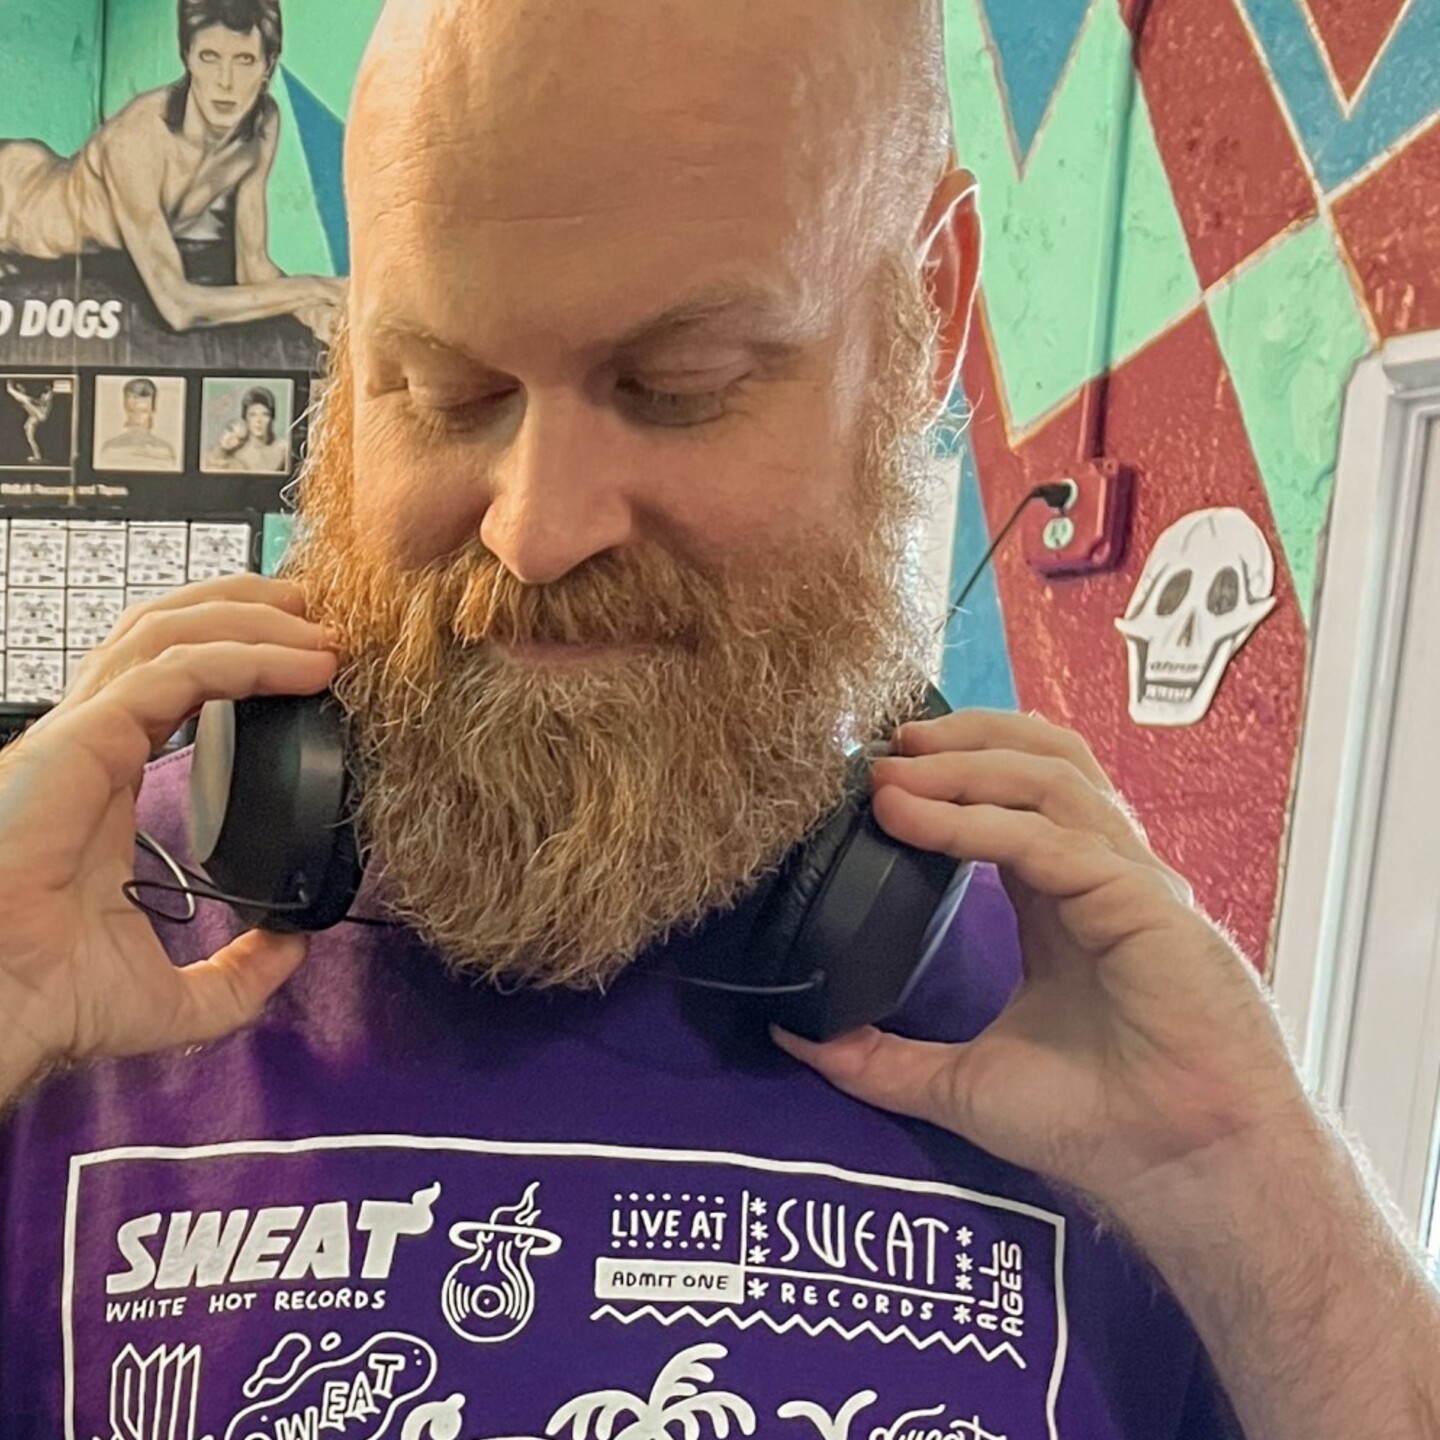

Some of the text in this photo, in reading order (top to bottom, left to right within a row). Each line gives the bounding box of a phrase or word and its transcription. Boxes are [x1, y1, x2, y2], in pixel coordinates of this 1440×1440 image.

[19, 299, 123, 339] DOGS
[106, 1181, 441, 1294] SWEAT
[612, 1209, 727, 1242] LIVE AT
[776, 1198, 949, 1285] SWEAT
[612, 1270, 729, 1291] ADMIT ONE
[979, 1241, 1000, 1330] ALL
[1001, 1240, 1024, 1337] AGES
[106, 1287, 386, 1322] WHITE HOT RECORDS
[781, 1282, 933, 1321] RECORDS
